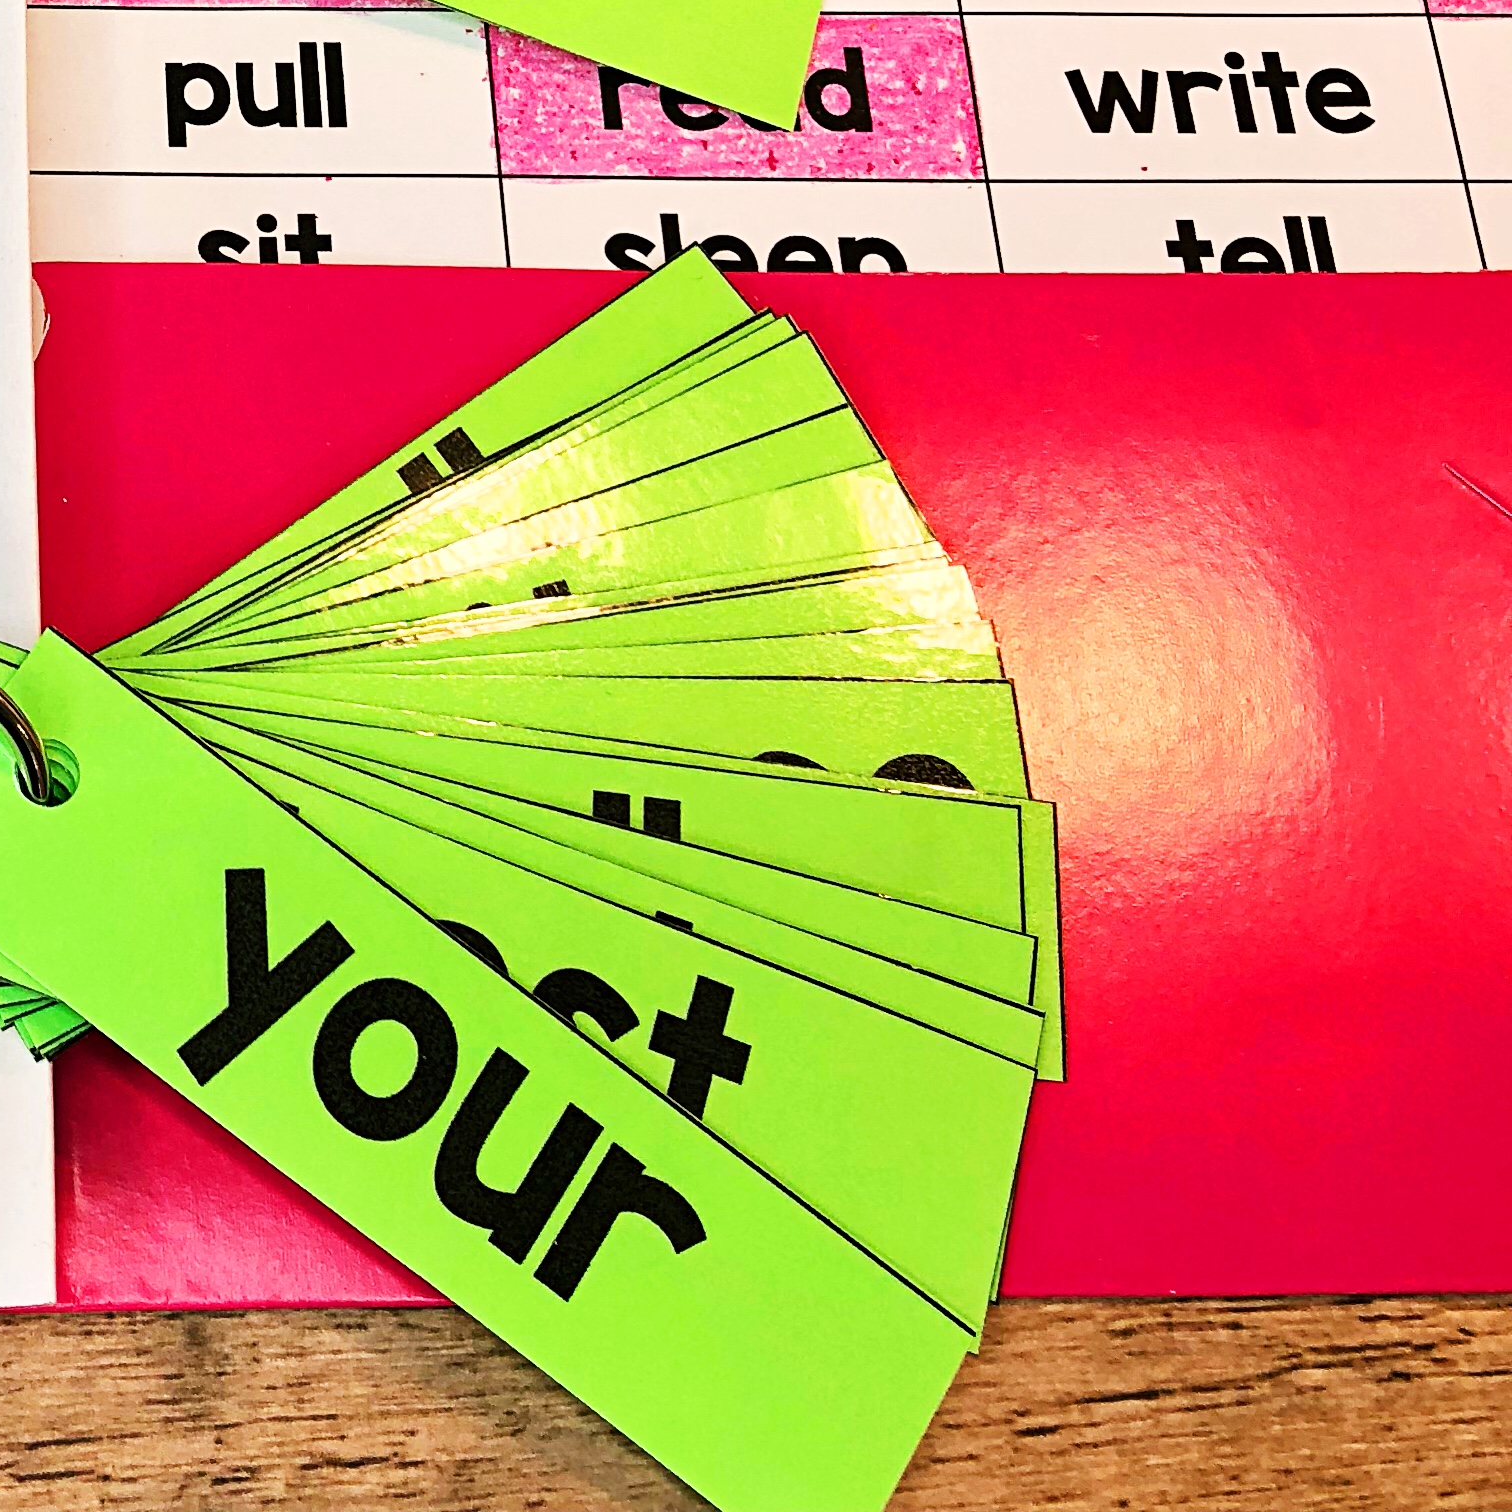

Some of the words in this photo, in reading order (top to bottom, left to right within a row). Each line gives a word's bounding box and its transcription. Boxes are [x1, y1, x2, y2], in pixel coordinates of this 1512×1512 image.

[165, 42, 347, 147] pull
[598, 47, 873, 133] red
[1065, 52, 1375, 133] write
[176, 868, 707, 1302] your
